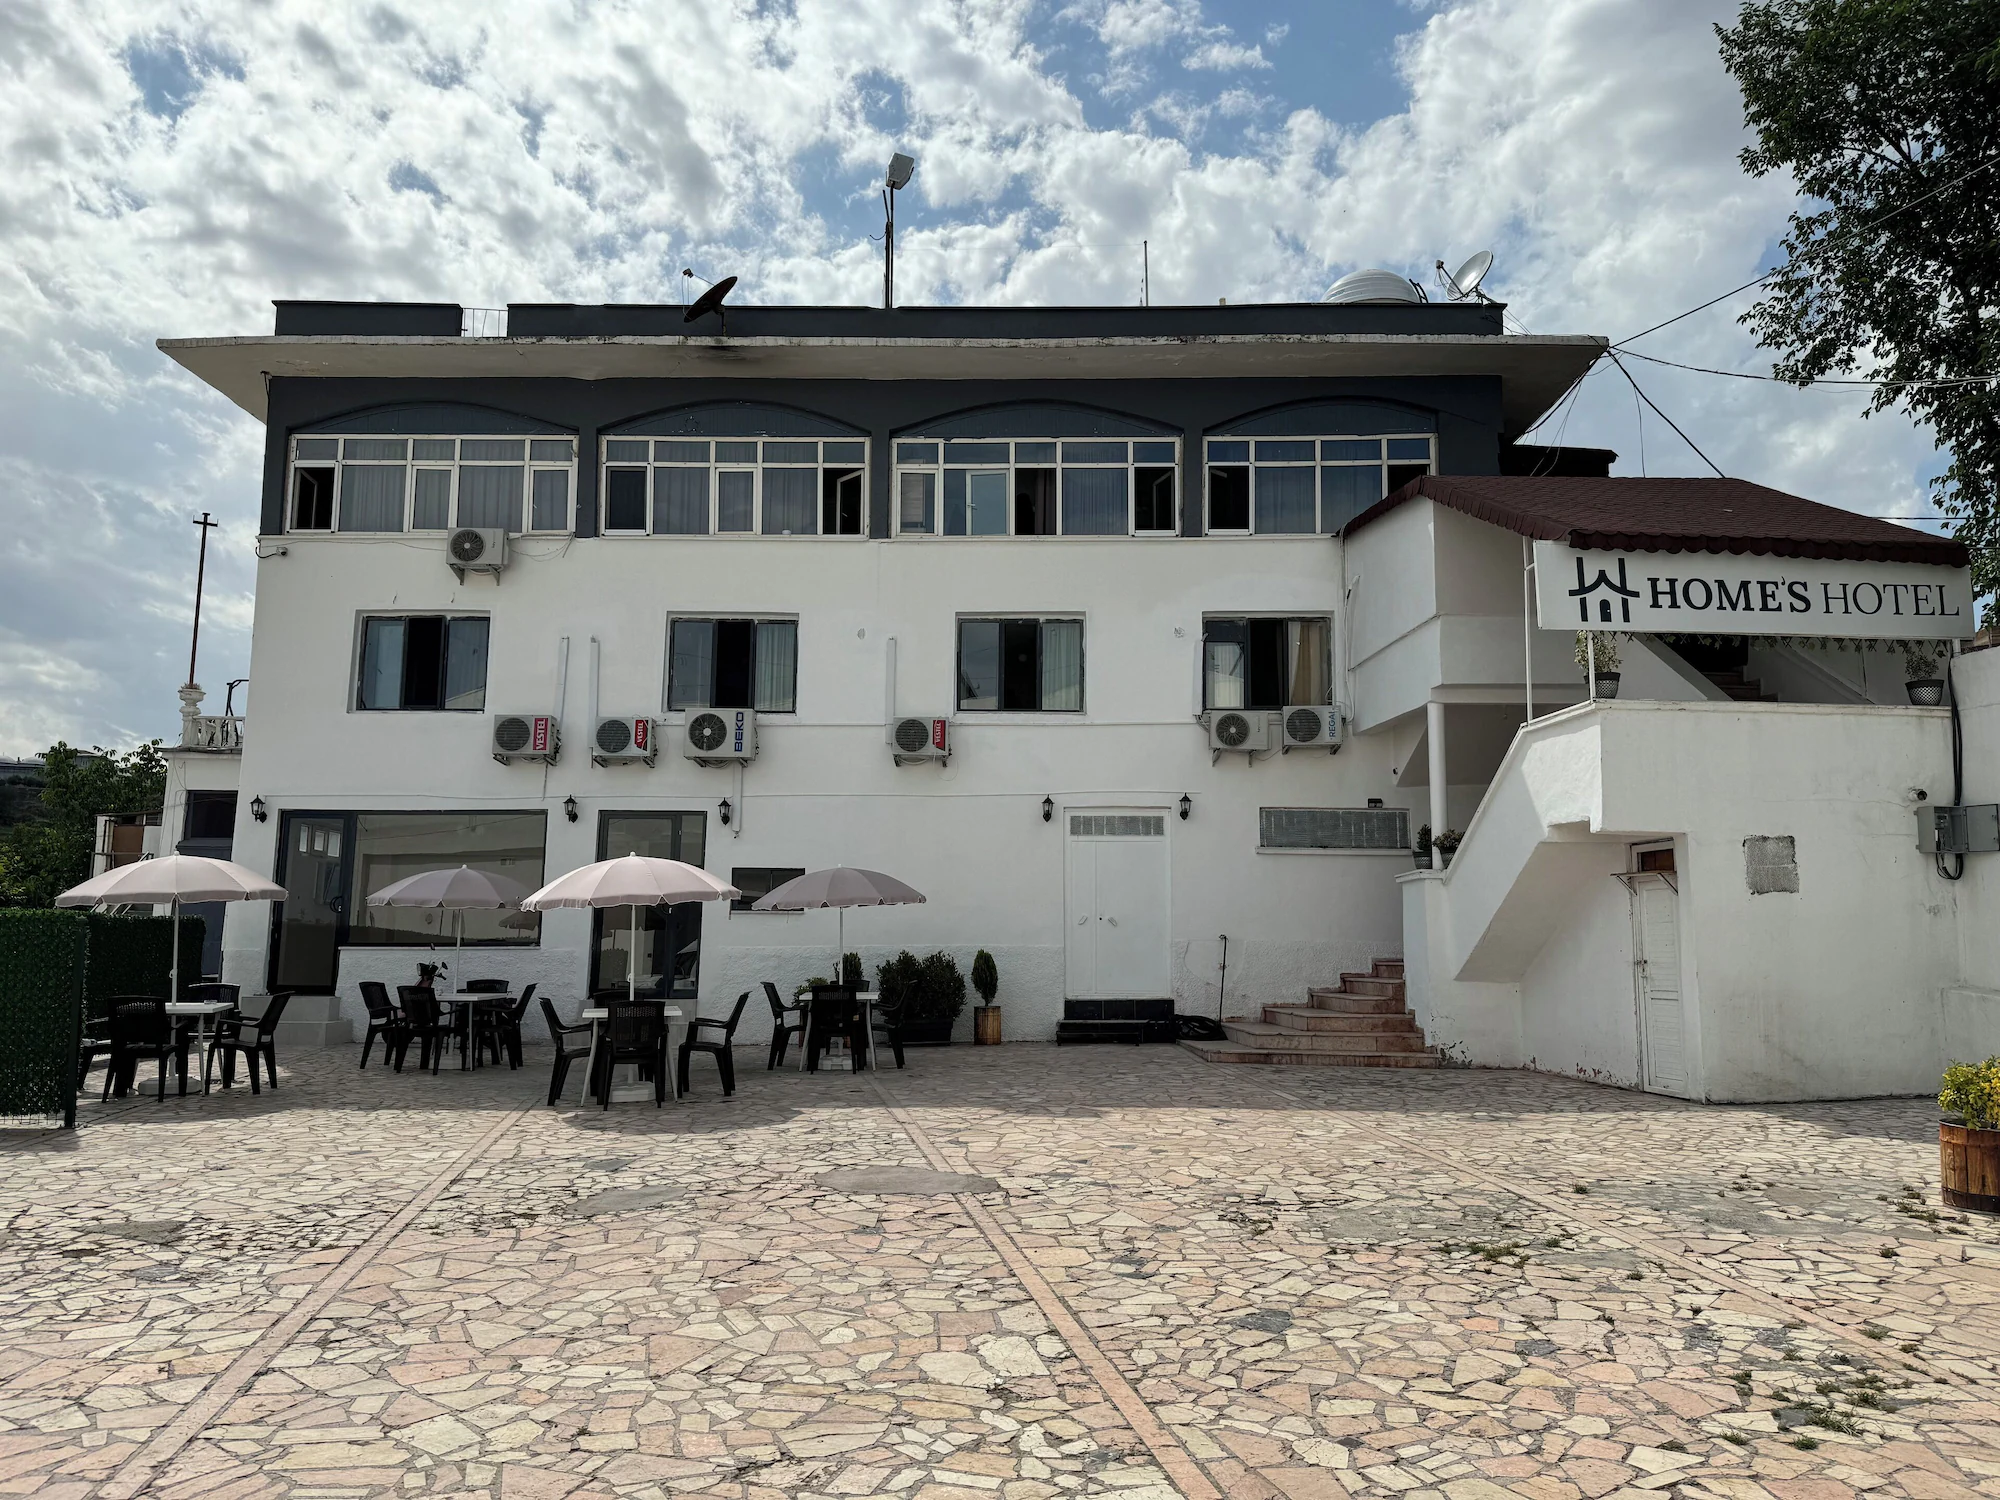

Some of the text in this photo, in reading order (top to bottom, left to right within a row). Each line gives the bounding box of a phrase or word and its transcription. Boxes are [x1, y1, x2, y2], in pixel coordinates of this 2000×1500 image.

[1647, 575, 1960, 617] HOME'S HOTEL
[536, 719, 546, 750] VESTEL
[734, 711, 744, 752] BEKO
